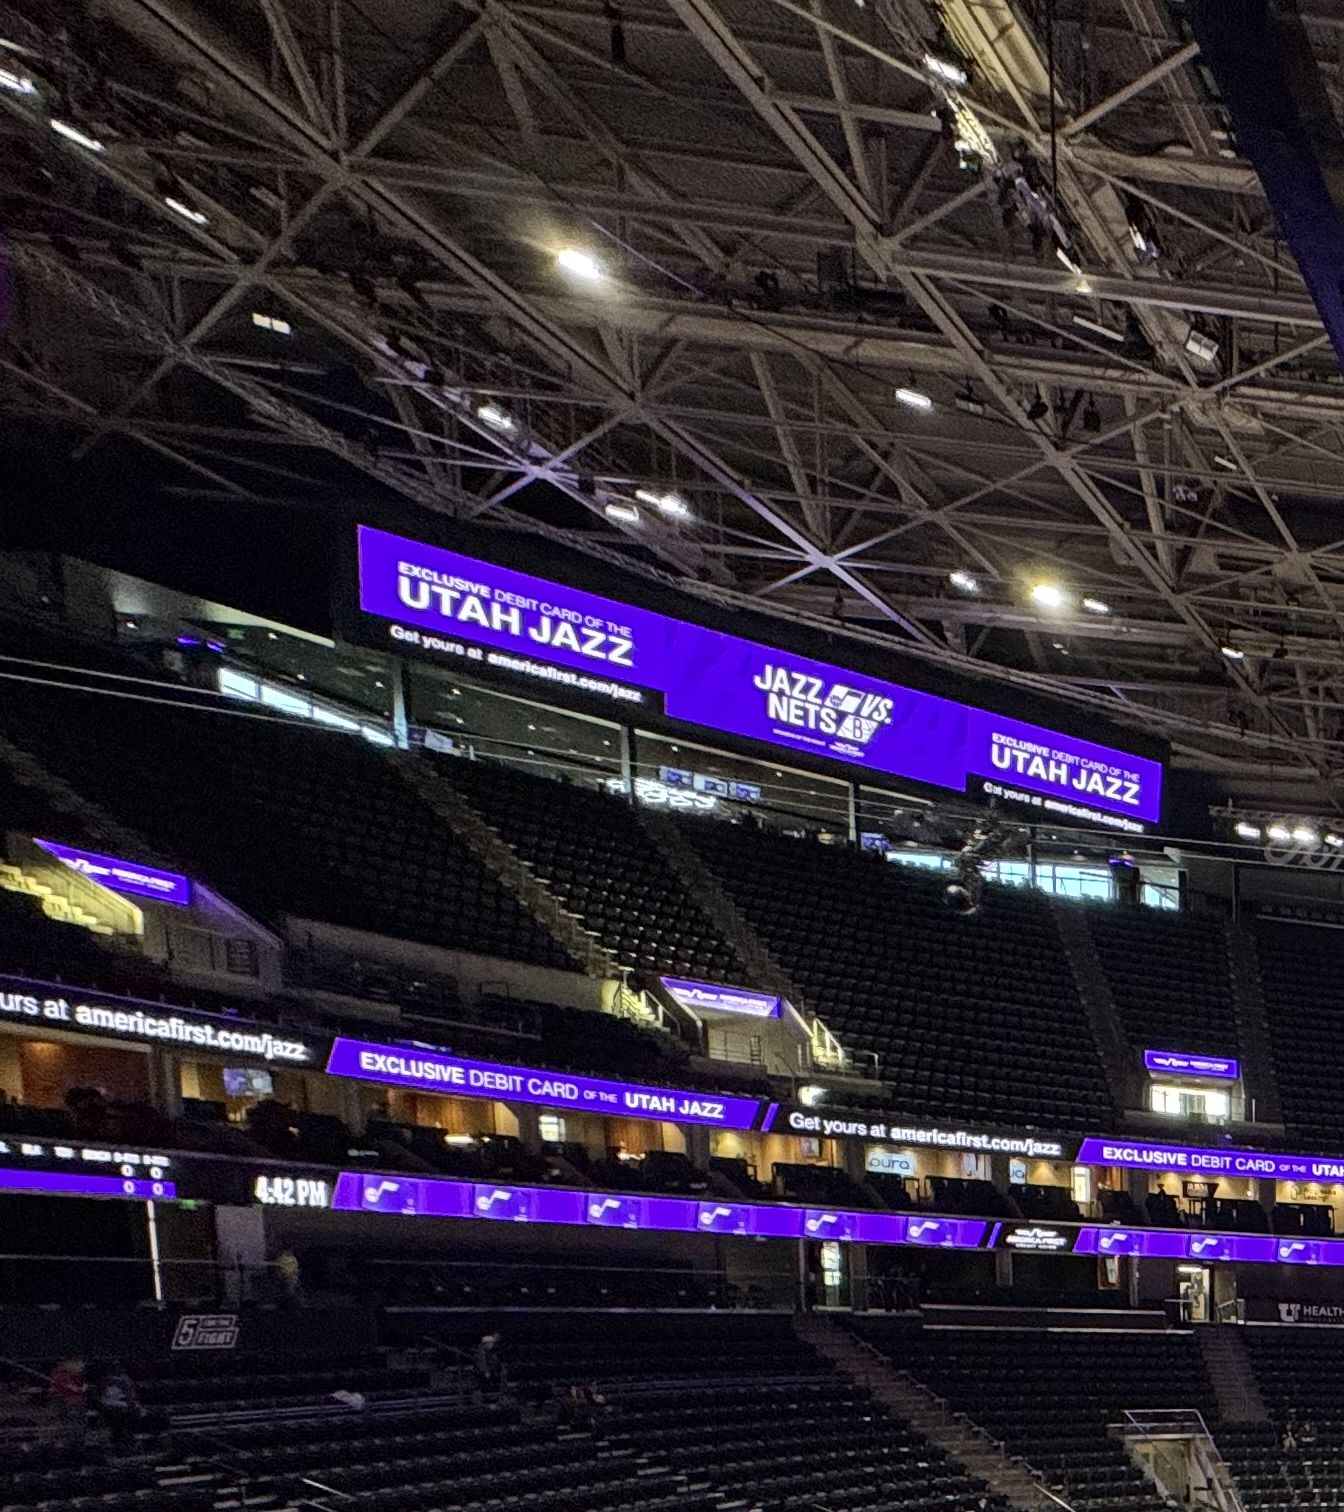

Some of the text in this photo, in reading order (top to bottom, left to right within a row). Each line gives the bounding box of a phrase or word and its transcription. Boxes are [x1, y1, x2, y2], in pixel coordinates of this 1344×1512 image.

[398, 560, 634, 637] EXCLUSIVE DEBIT CARD OF THE
[398, 575, 634, 667] UTAH JAZZ
[390, 624, 644, 703] Get yours at americafirst.com/jazz
[753, 664, 894, 724] JAZZ VS.
[767, 692, 837, 734] NETS
[991, 732, 1050, 757] EXCLUSIVE
[991, 743, 1141, 806] UTAH JAZZ
[43, 999, 69, 1020] at
[75, 1005, 310, 1060] americafirst.com/jazz
[360, 1051, 465, 1084] EXCLUSIVE
[469, 1069, 523, 1092] DEBIT
[527, 1078, 578, 1100] CARD
[625, 1092, 676, 1112] UTAH
[678, 1101, 724, 1119] JAZZ
[789, 1112, 1061, 1156] Get yours at americafirst.com/jazz
[1102, 1146, 1188, 1166] EXCLUSIVE
[1190, 1153, 1233, 1170] DEBIT
[1235, 1157, 1276, 1173] CARD
[255, 1176, 328, 1207] 4:42 PM
